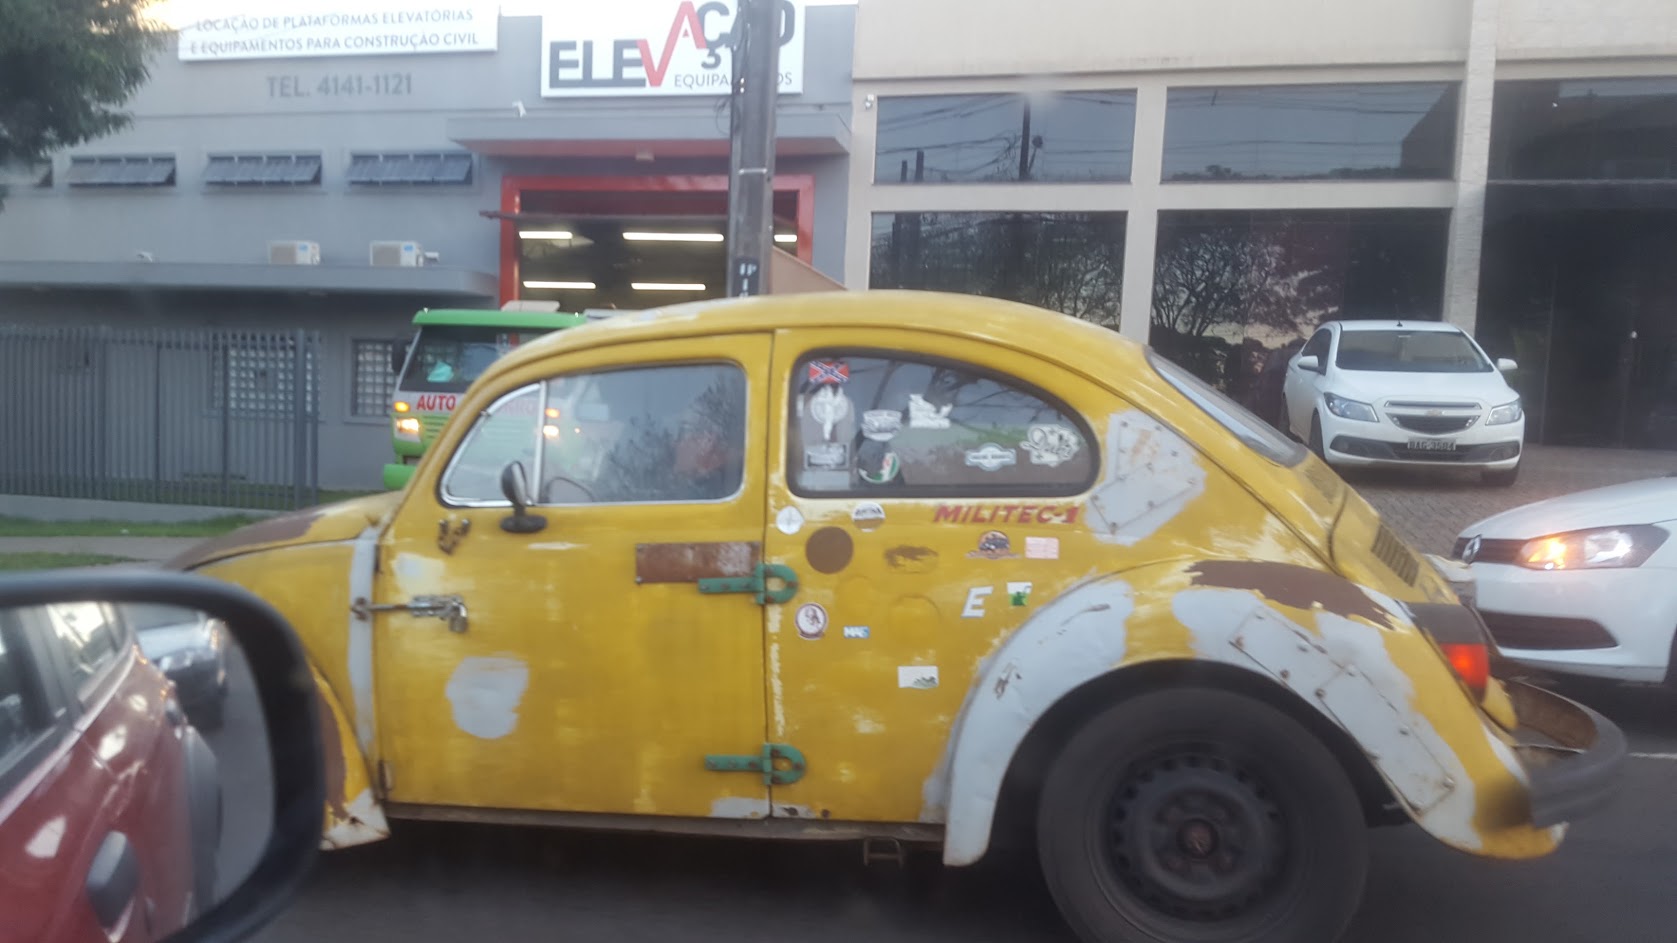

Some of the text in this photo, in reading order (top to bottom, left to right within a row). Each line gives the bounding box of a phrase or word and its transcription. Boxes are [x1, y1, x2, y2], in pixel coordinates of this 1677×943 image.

[197, 8, 474, 33] LOCAÇÃO DE PLATAFORMAS ELEVATÓRIAS
[200, 38, 303, 55] EQUIPAMENTOS
[306, 36, 341, 49] PARA
[344, 31, 440, 50] CONSTRUÇÃO
[443, 32, 479, 45] CIVIL
[265, 73, 413, 98] TEL. 4141-1121
[416, 395, 456, 411] AUTO
[933, 504, 1080, 523] MILITEC-1
